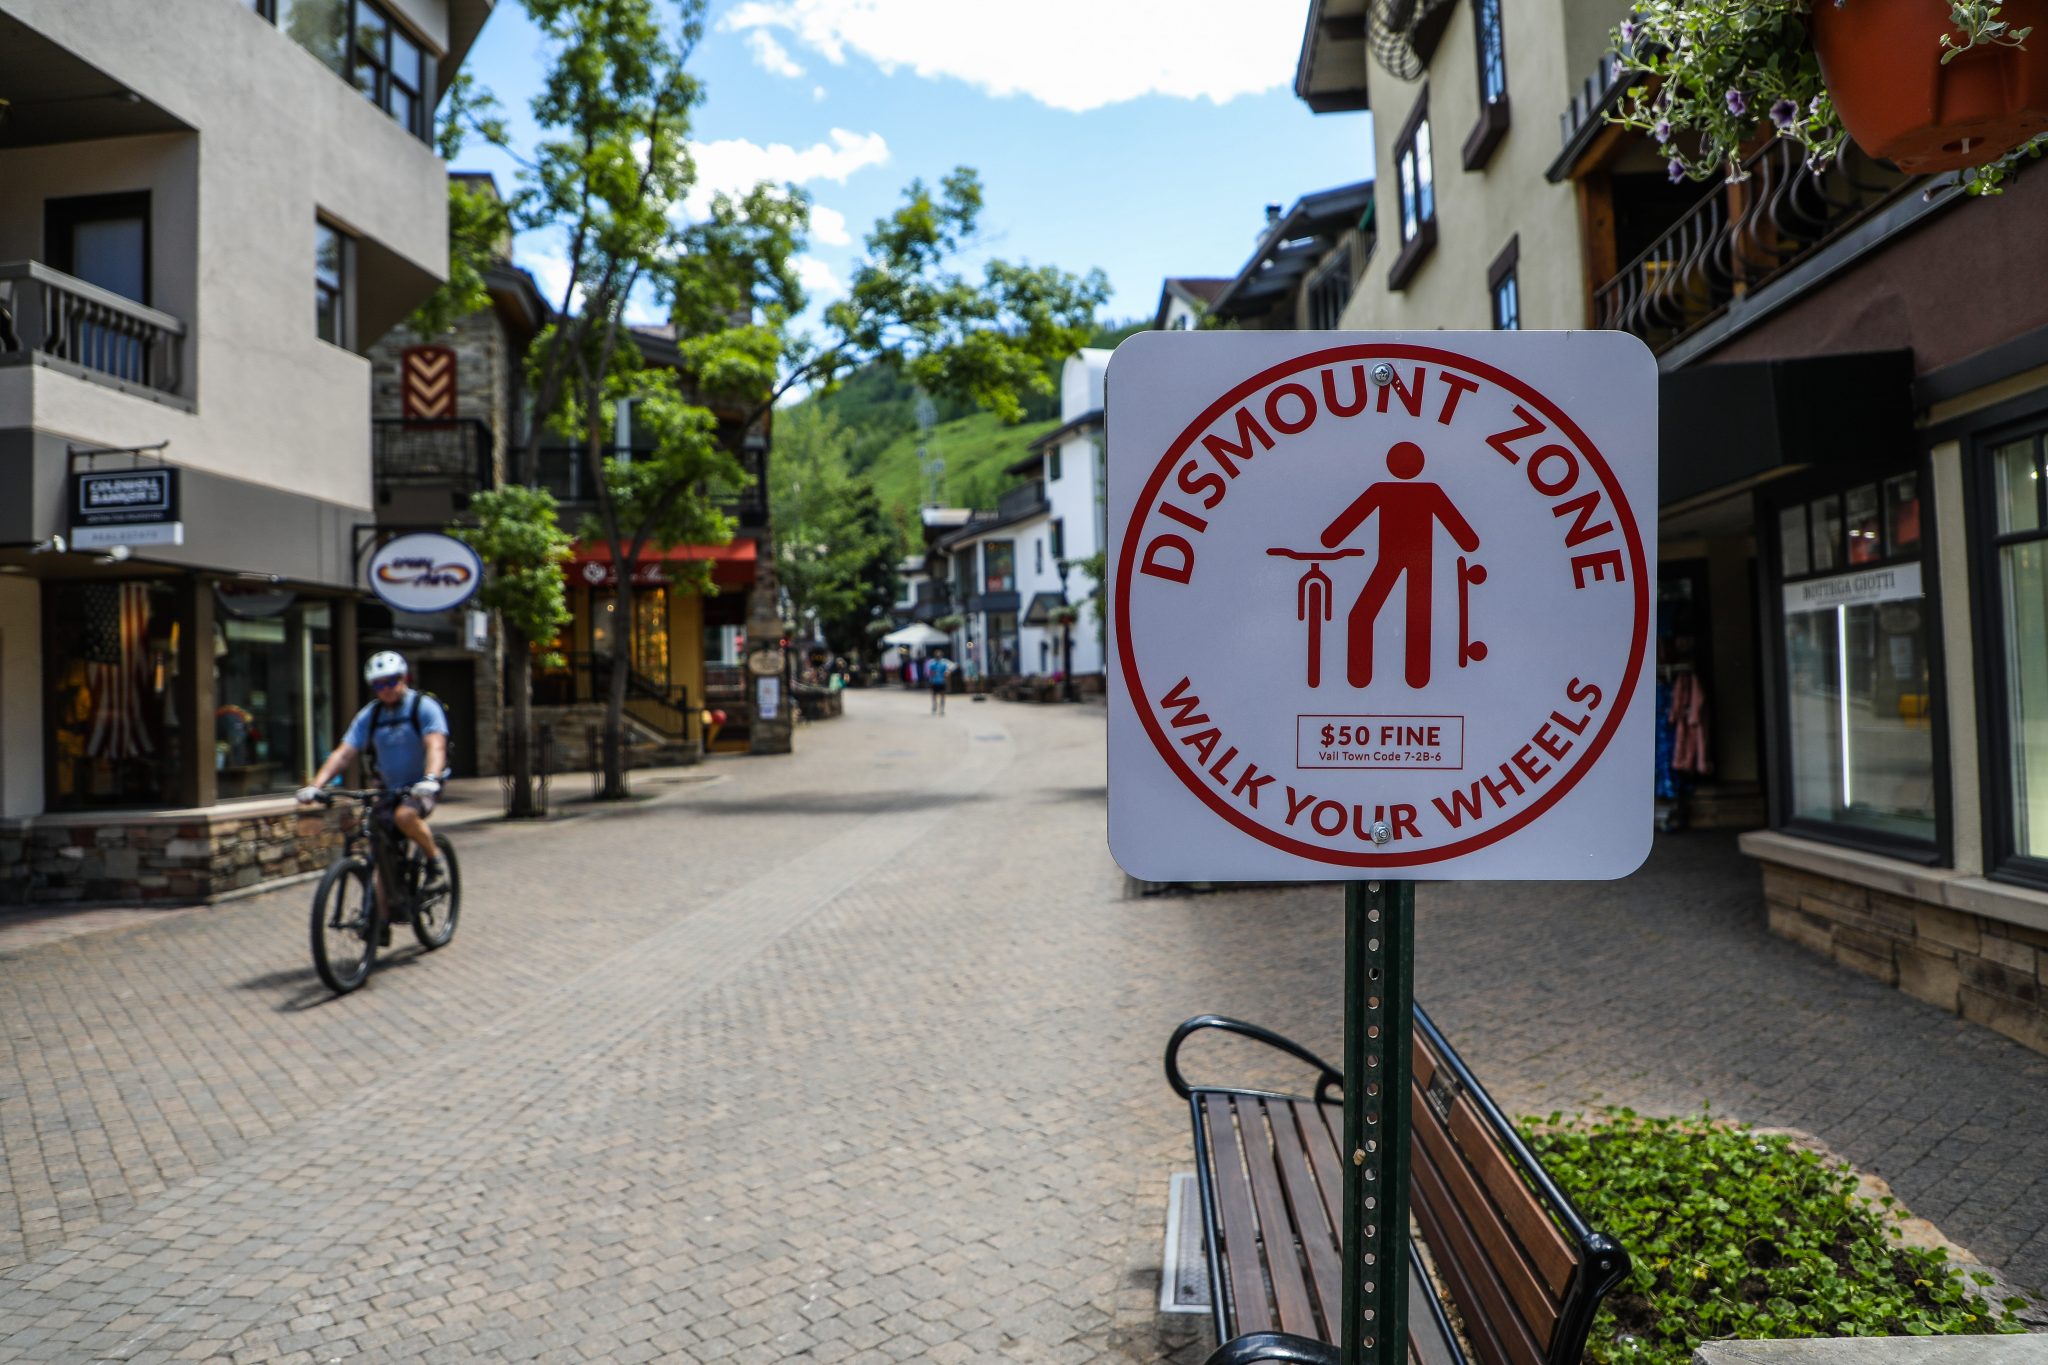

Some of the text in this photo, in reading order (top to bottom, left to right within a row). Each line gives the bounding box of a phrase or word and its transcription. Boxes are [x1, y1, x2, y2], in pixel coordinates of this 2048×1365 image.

[1140, 364, 1626, 590] DISMOUNT ZONE
[1853, 570, 1896, 593] GIOTTI
[1321, 723, 1441, 748] $50 FINE
[1159, 677, 1603, 842] WALK YOUR WHEELS
[1319, 751, 1442, 762] Vail Town Code 7-2B-6
